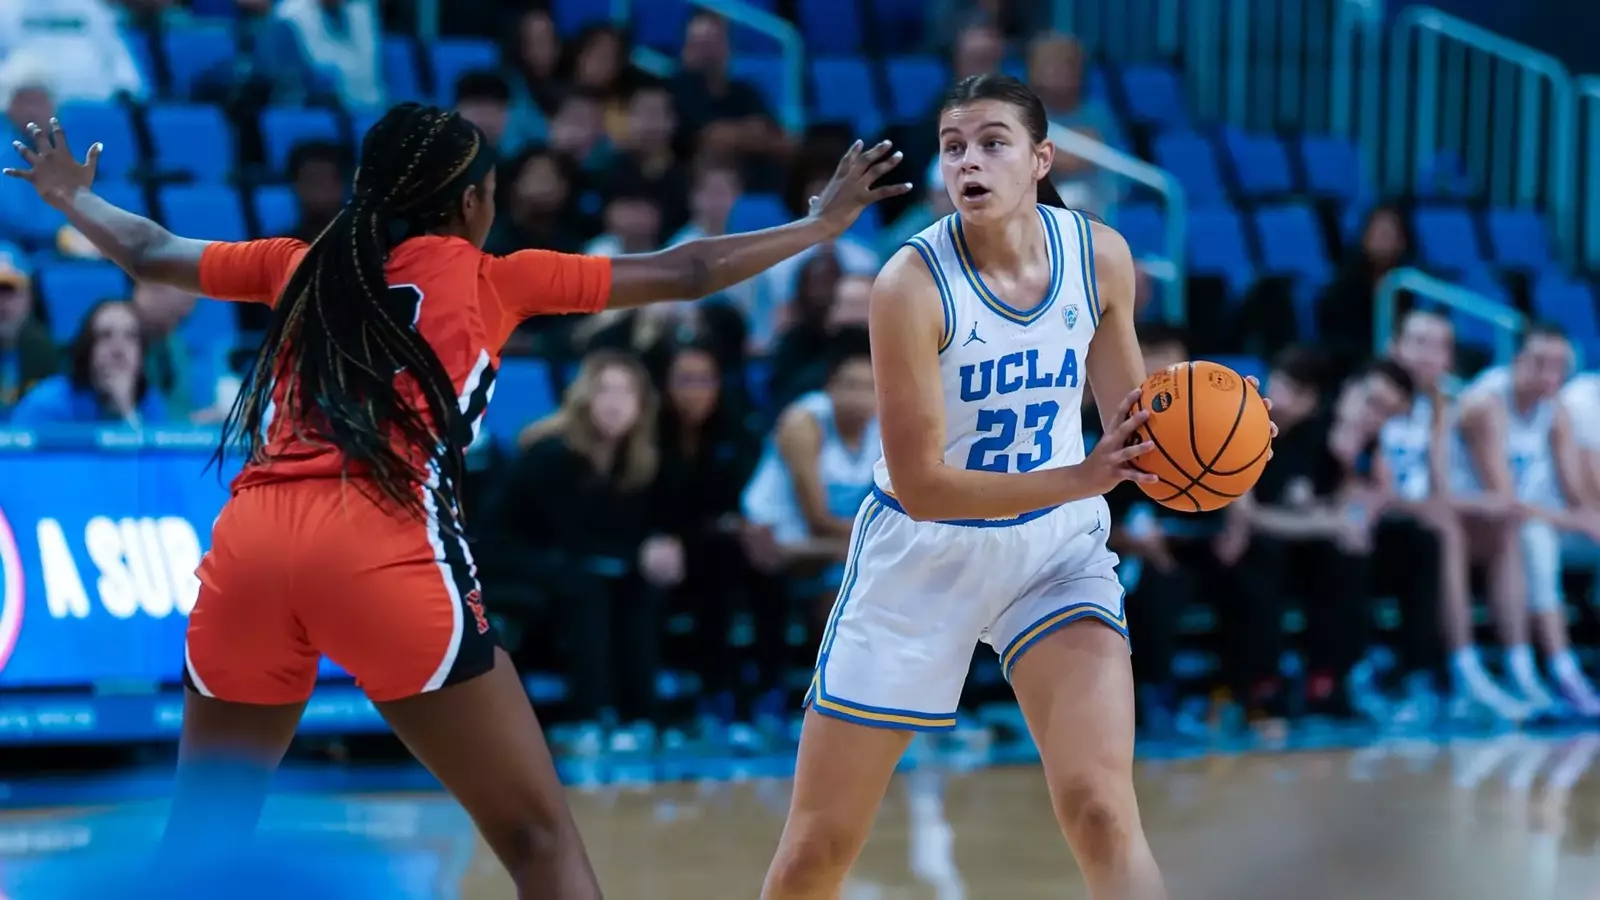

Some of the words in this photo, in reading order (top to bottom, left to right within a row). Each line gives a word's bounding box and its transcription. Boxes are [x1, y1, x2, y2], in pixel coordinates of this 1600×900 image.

[959, 348, 1078, 402] UCLA
[966, 400, 1060, 473] 23
[36, 517, 91, 619] A
